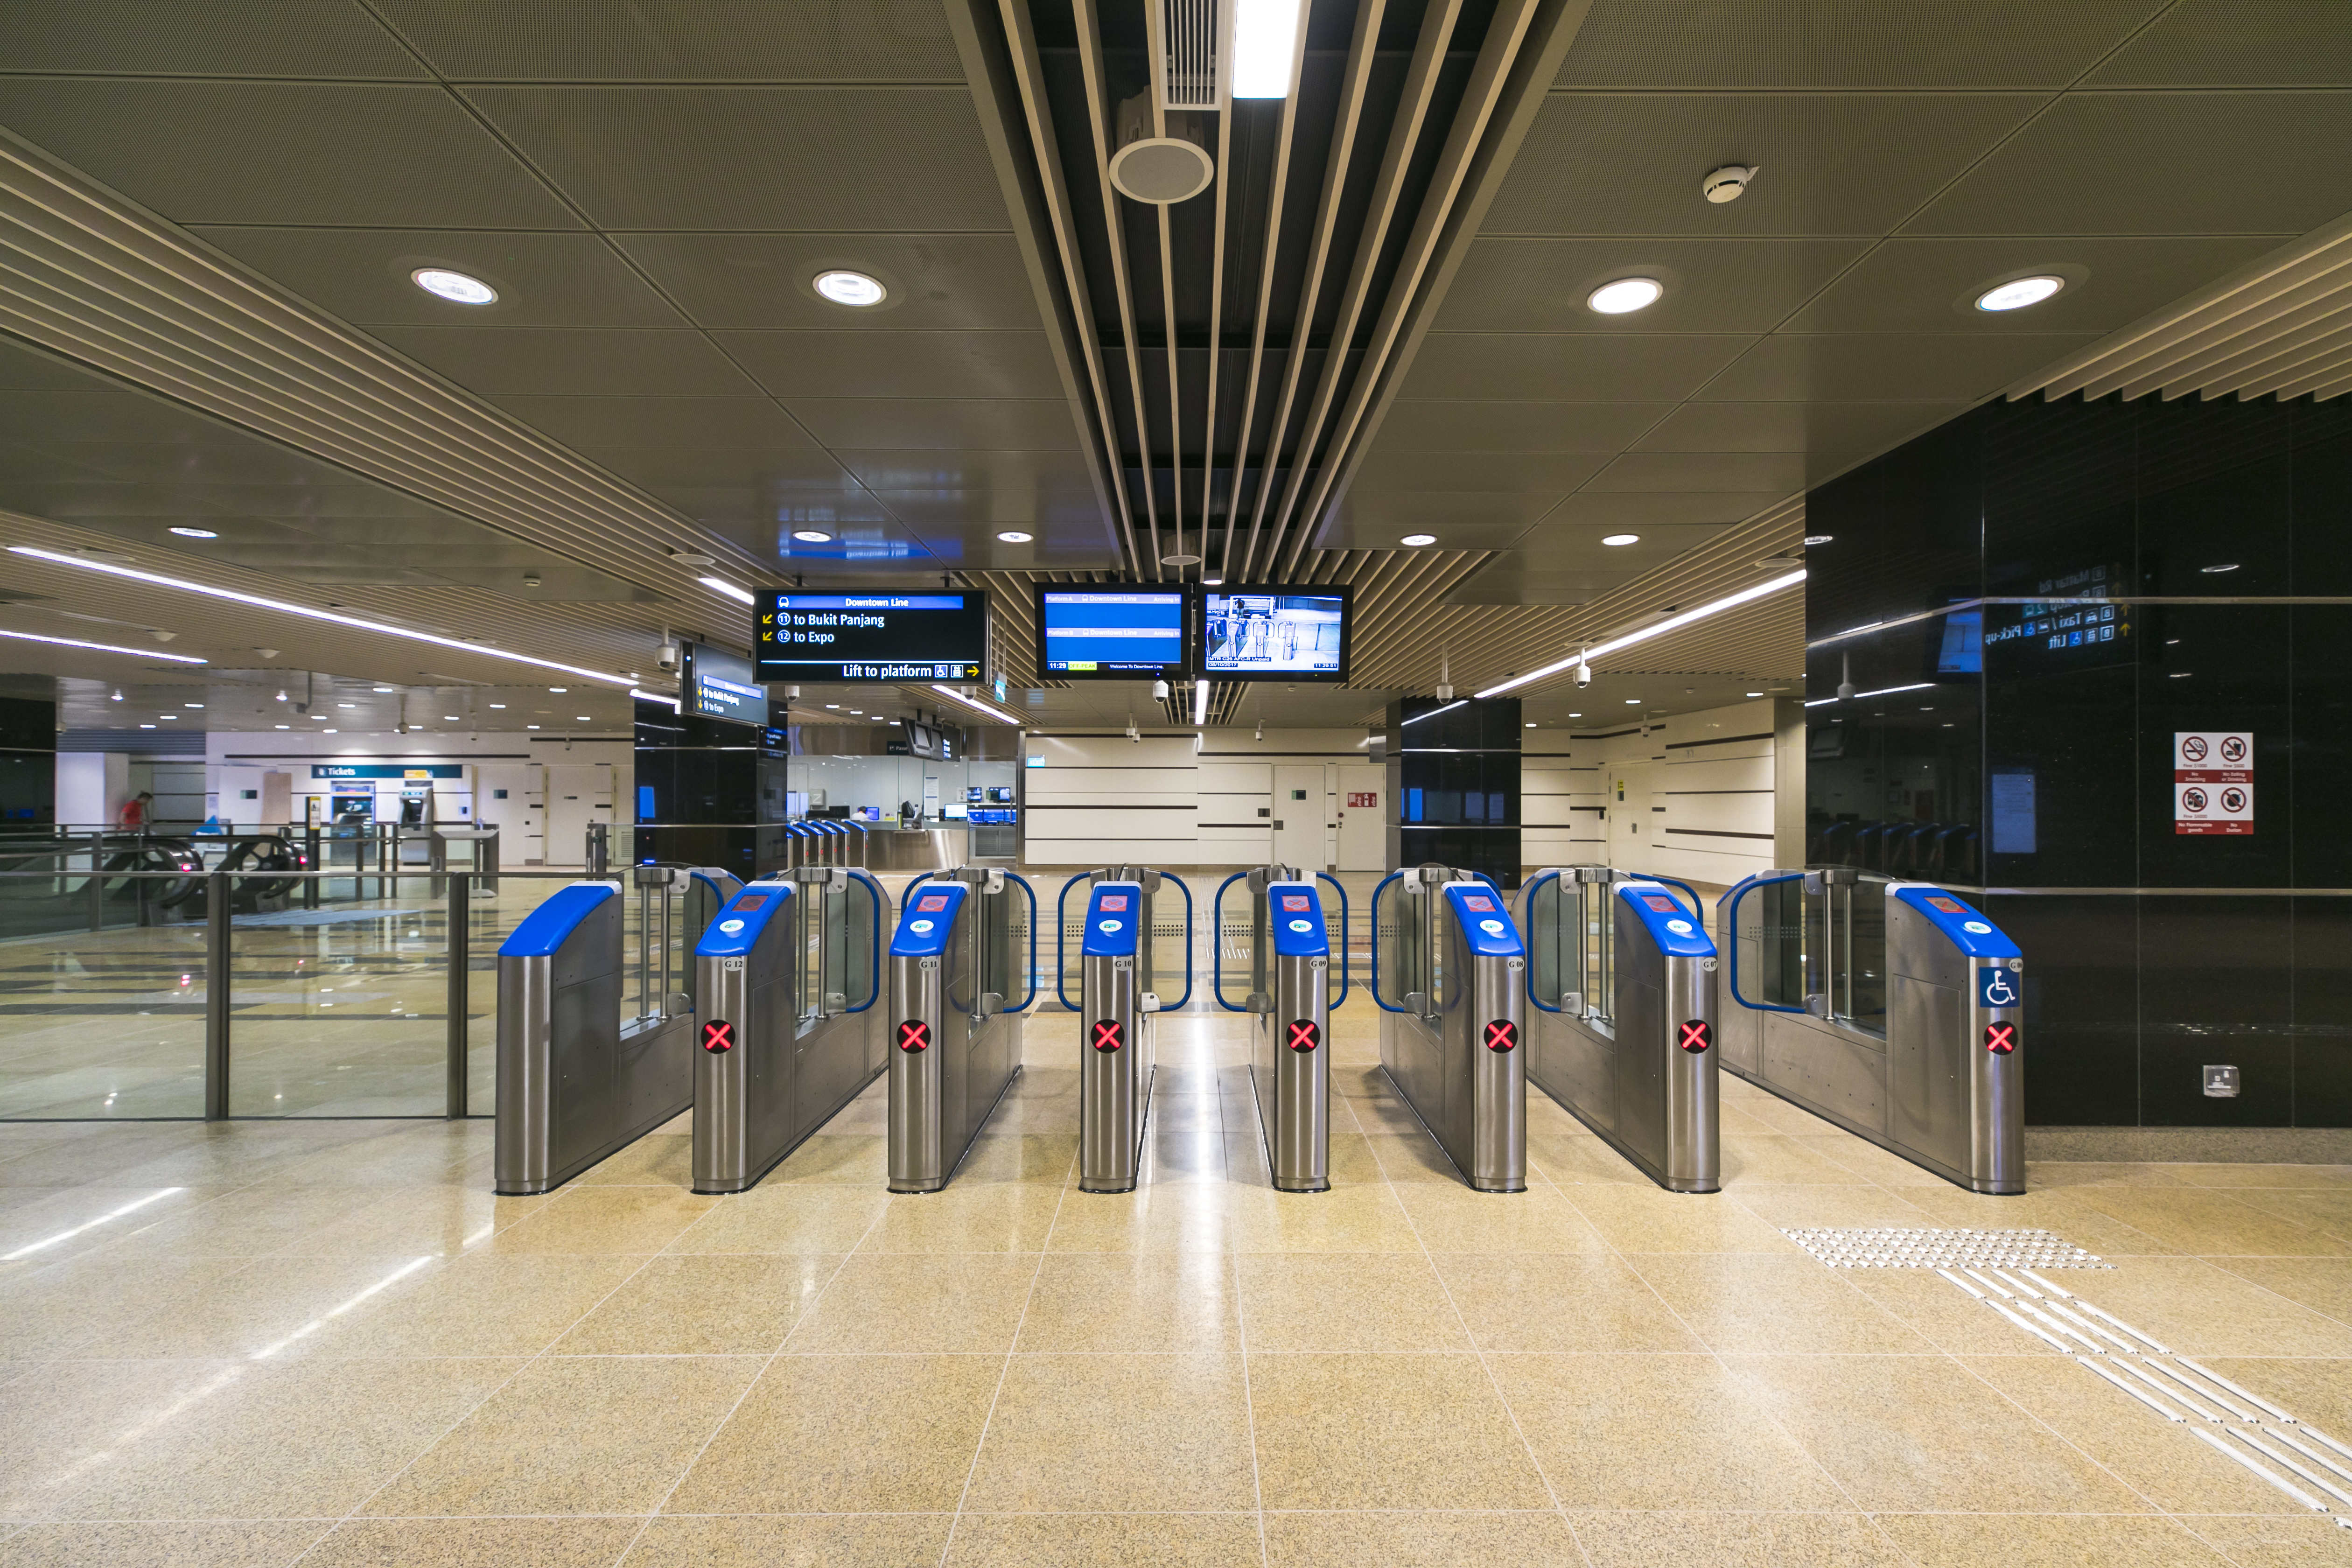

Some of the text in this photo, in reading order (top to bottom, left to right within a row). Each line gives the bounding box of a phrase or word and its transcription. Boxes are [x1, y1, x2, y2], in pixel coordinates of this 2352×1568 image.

[846, 598, 909, 607] Downtown Line
[794, 615, 805, 624] to
[809, 614, 837, 625] Bukit
[840, 614, 884, 628] Panjang
[794, 633, 805, 642] to
[809, 632, 834, 644] Expo
[843, 665, 931, 679] Lift to platform
